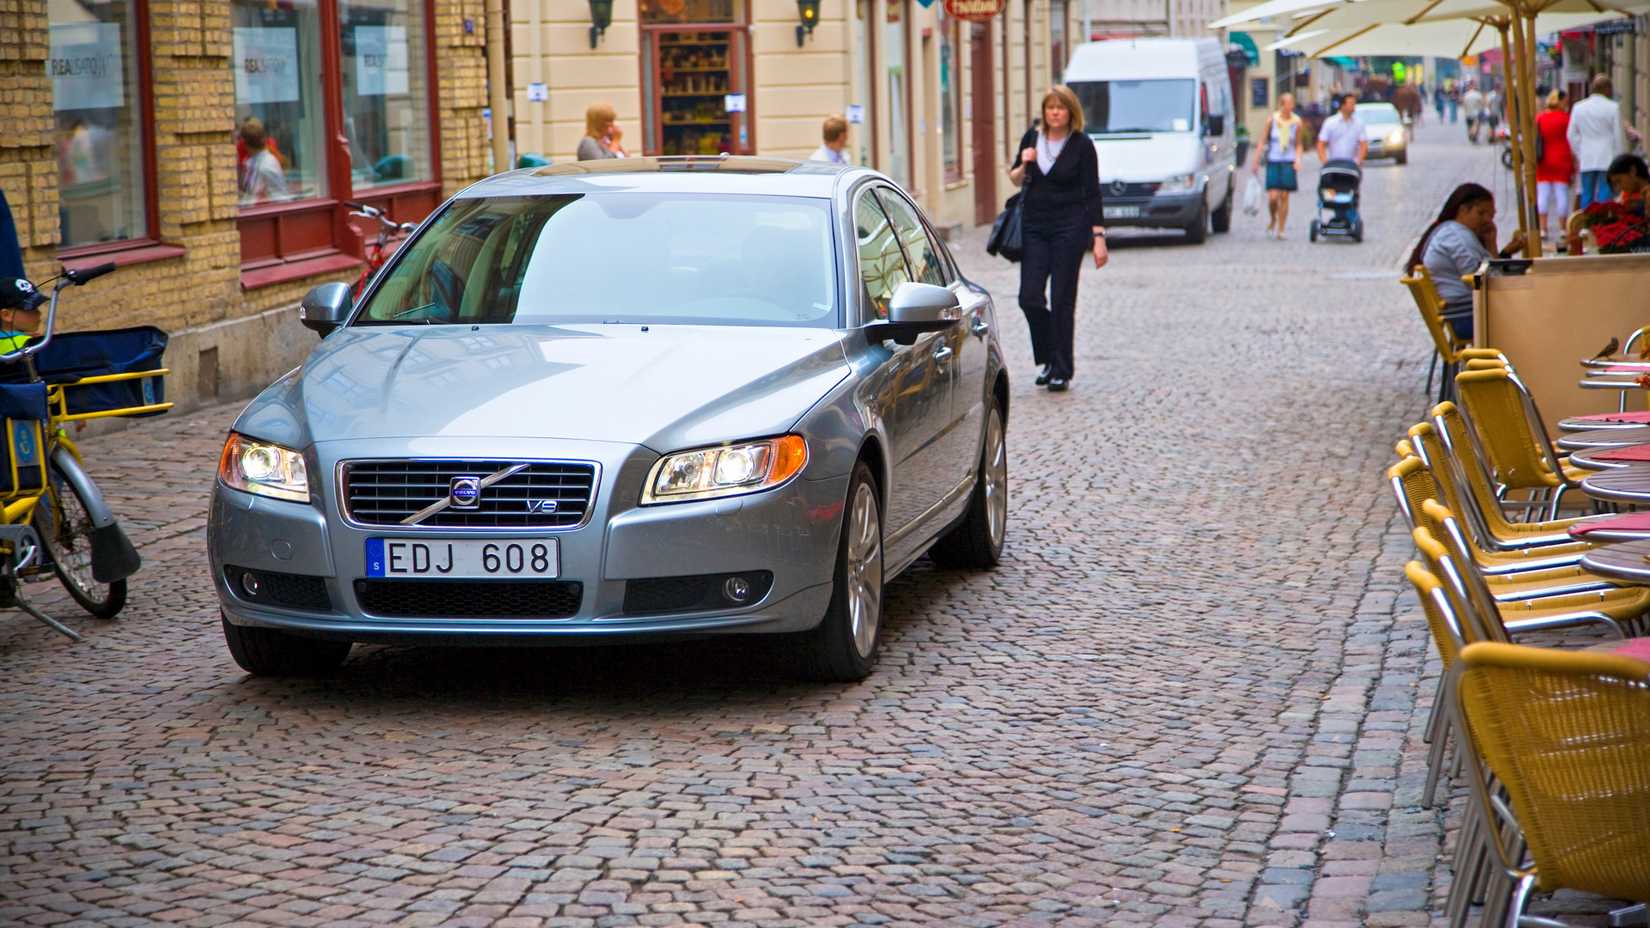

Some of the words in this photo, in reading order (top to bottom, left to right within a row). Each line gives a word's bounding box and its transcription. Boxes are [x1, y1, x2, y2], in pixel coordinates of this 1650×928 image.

[454, 488, 477, 496] VOLVO
[526, 500, 558, 513] V8
[389, 543, 453, 573] EDJ
[482, 543, 549, 573] 608
[373, 562, 380, 571] S
